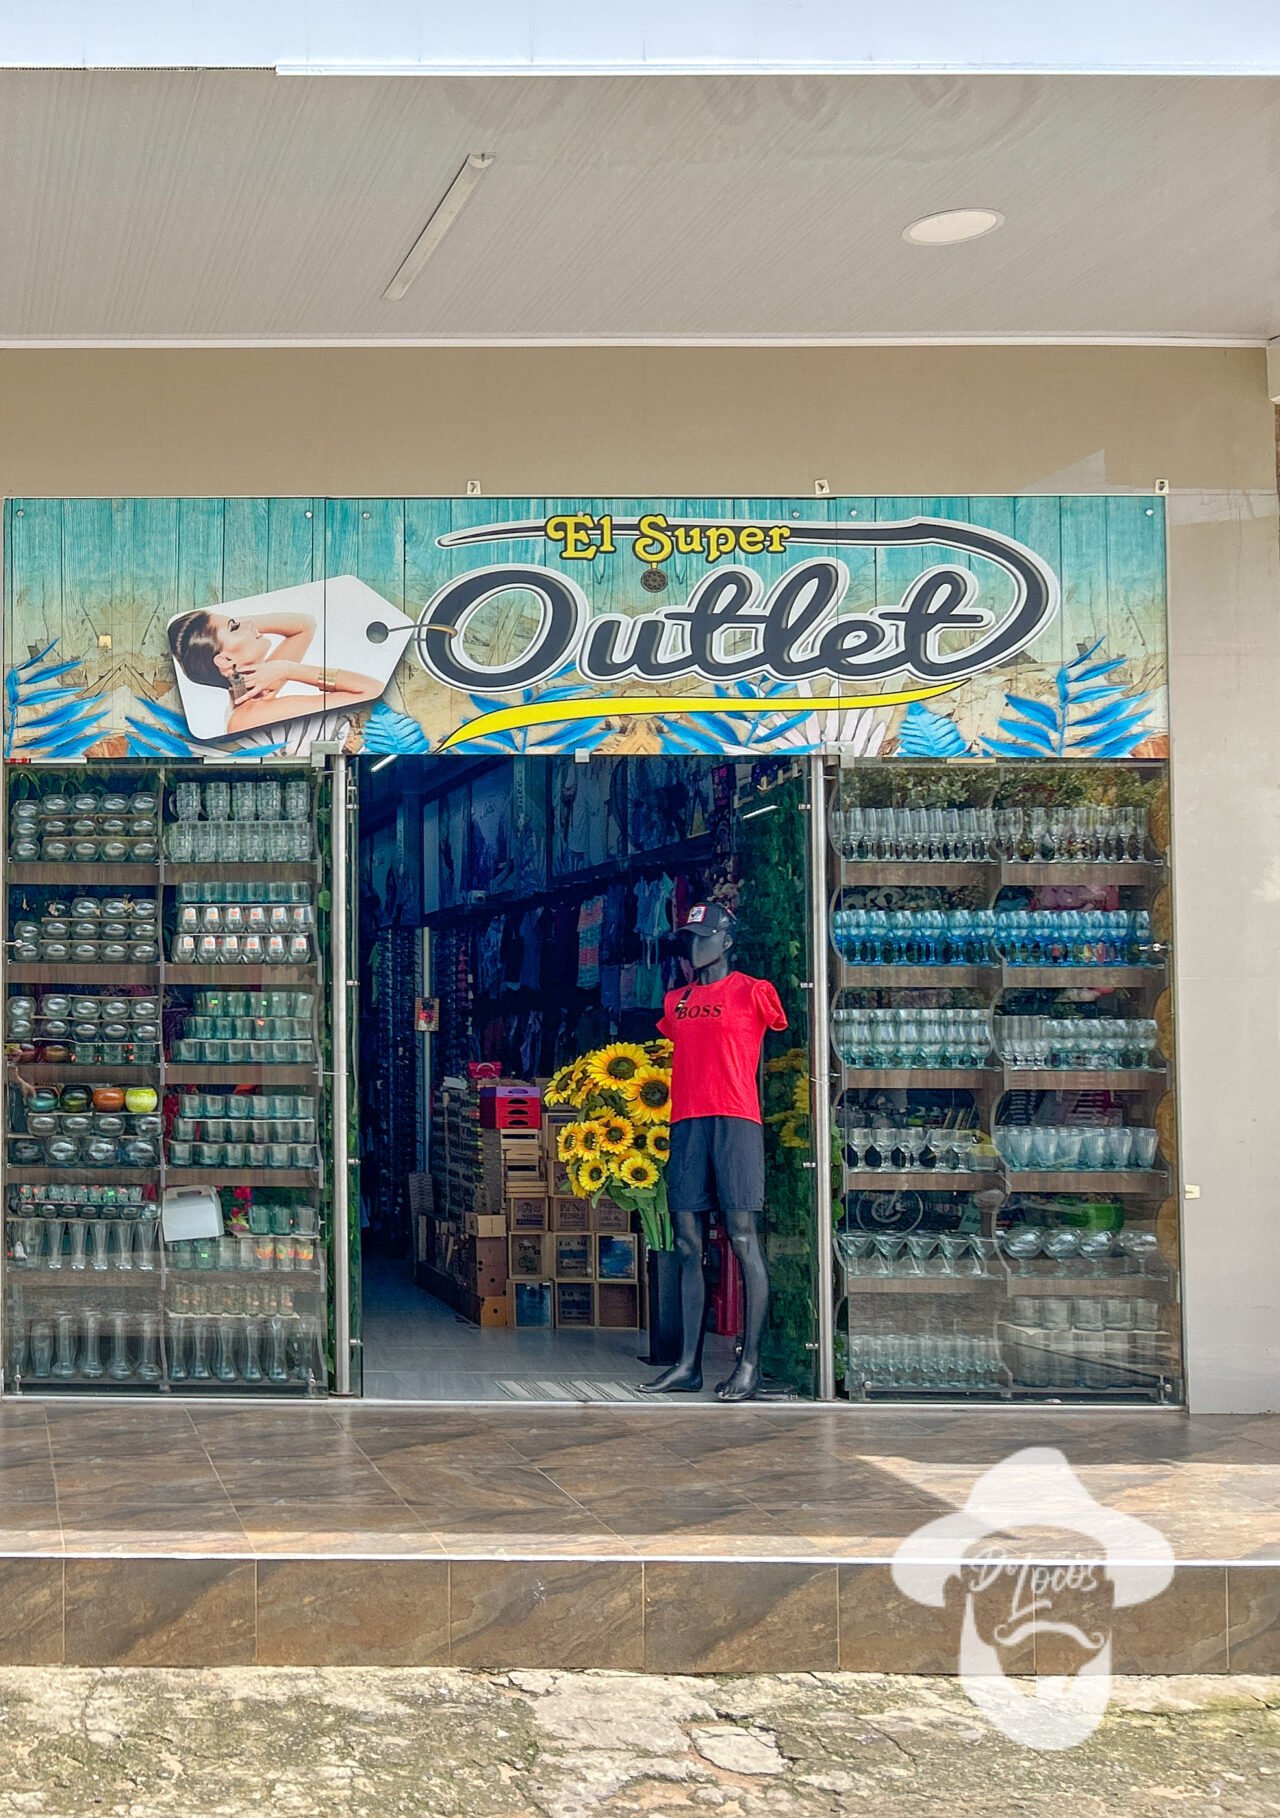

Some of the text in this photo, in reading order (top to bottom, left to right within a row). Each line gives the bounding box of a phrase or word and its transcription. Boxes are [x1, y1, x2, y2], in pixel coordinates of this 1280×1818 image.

[545, 513, 792, 563] El Super
[415, 552, 1020, 692] Outlet
[677, 1004, 723, 1020] BOSS
